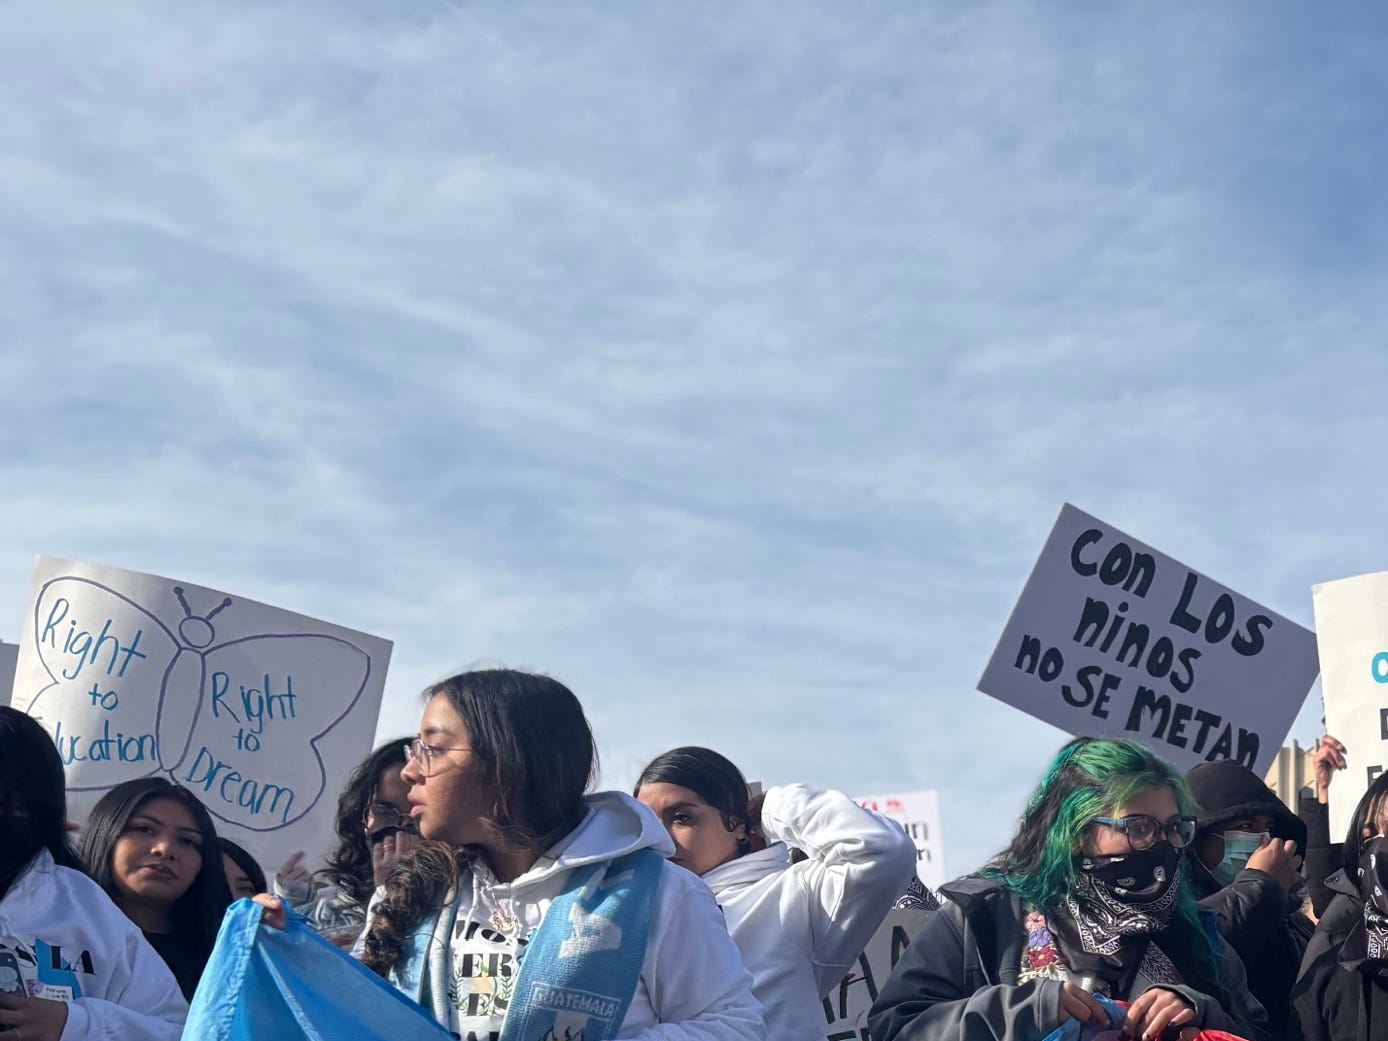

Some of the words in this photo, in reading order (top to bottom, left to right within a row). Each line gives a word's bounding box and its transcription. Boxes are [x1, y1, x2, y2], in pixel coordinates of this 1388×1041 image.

[42, 598, 147, 679] Right
[1170, 572, 1273, 656] LOS
[89, 684, 118, 711] to
[211, 672, 296, 733] Right
[1061, 666, 1121, 719] SE
[234, 728, 259, 751] to
[186, 747, 297, 822] Dream
[534, 986, 615, 1017] GUATEMALA
